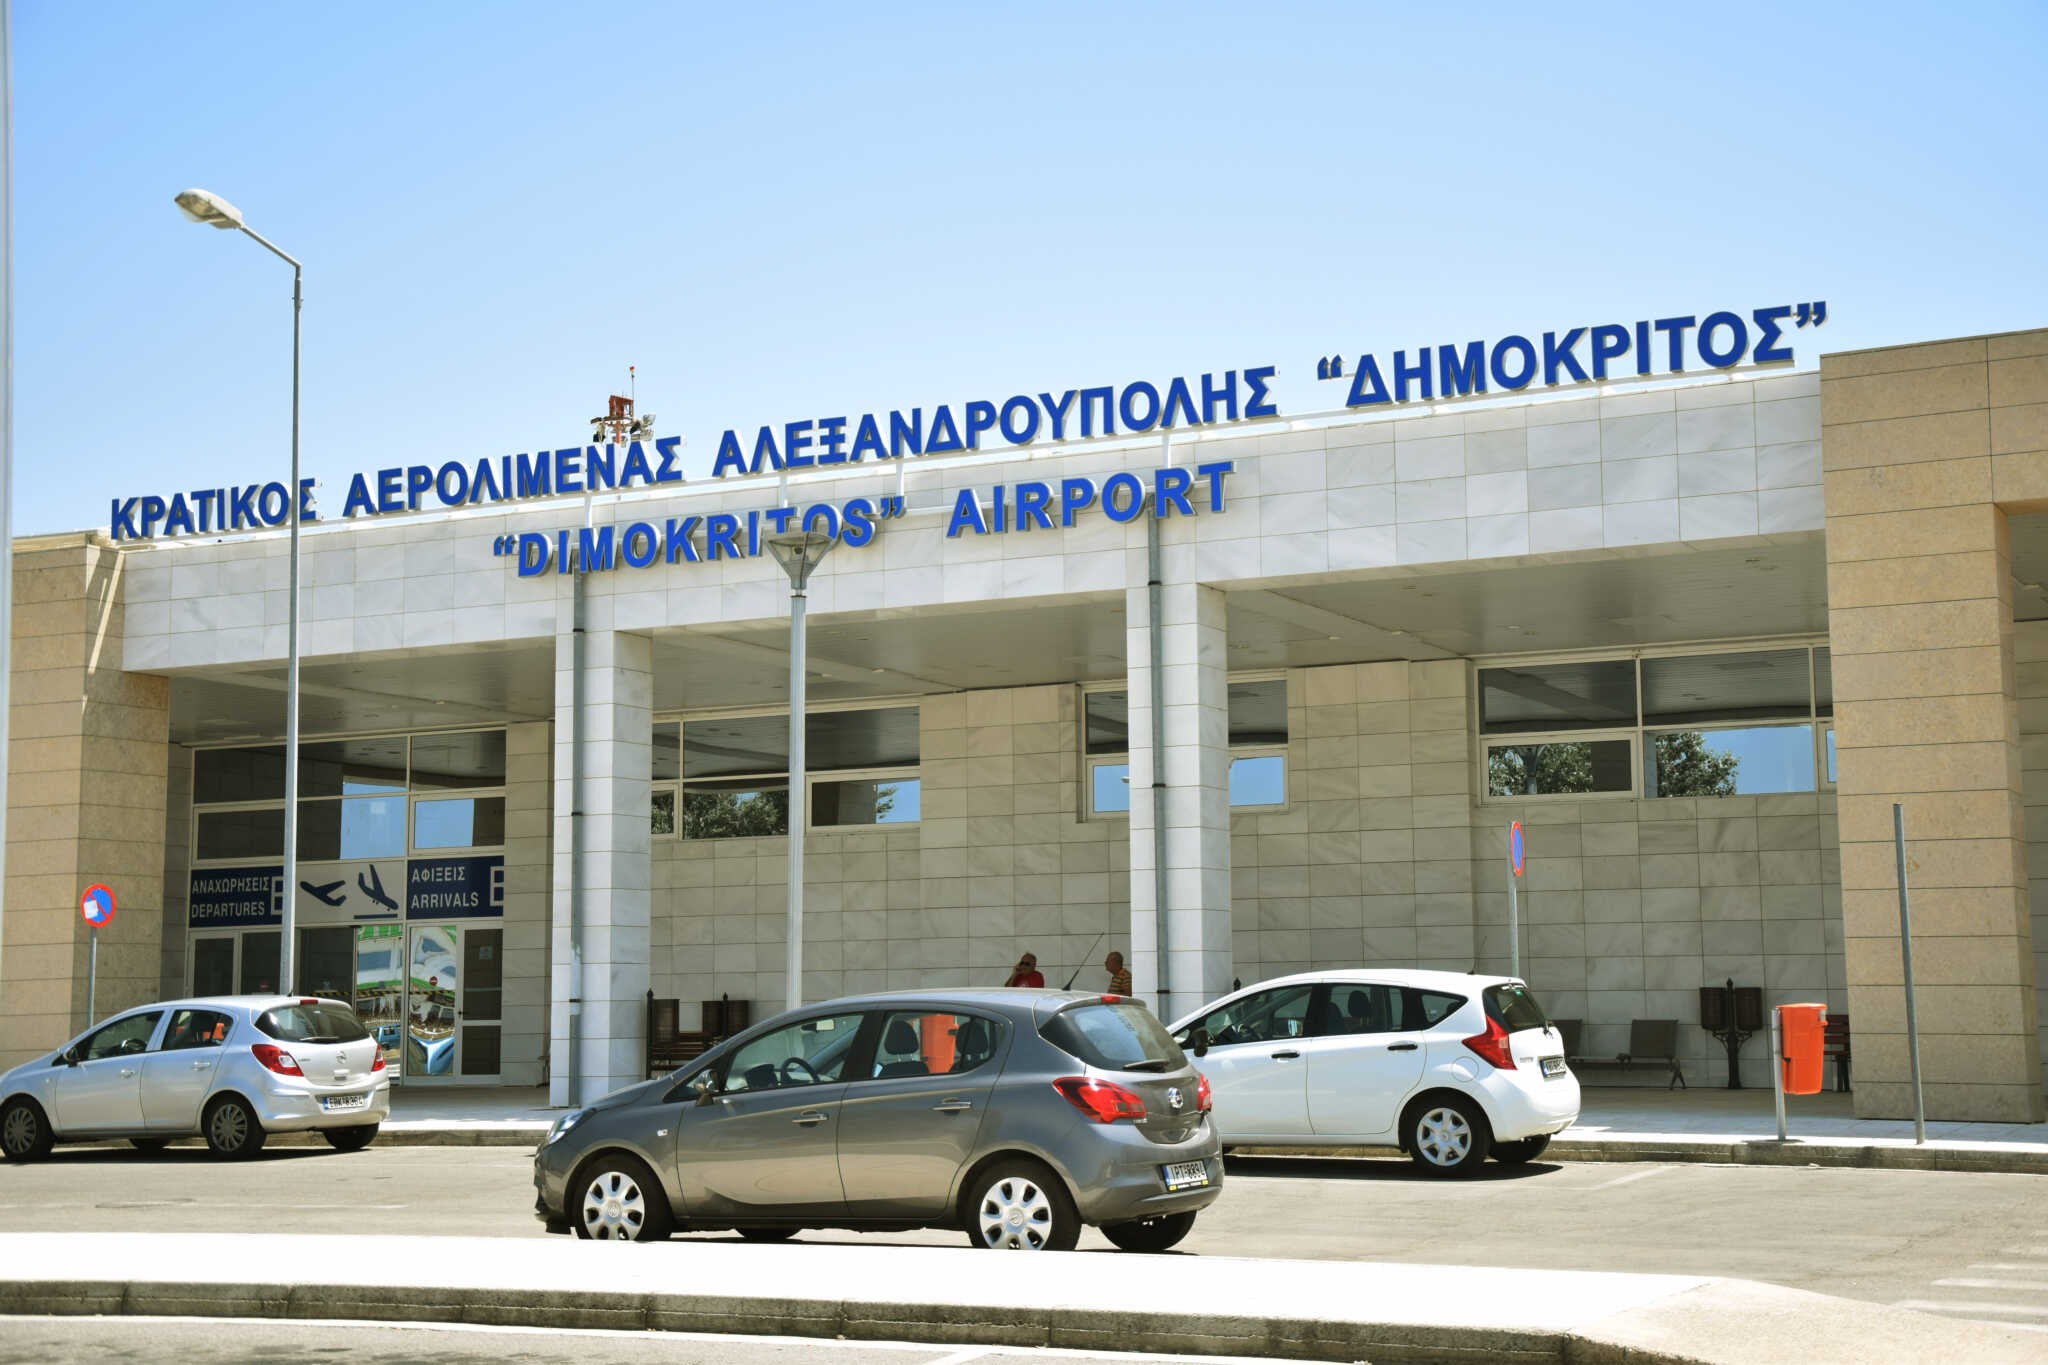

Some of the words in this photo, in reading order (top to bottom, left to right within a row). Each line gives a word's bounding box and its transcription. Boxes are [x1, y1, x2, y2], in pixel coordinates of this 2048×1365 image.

[111, 478, 317, 540] ΚΡΑΤΙΚΟΣ
[343, 435, 682, 517] ΑΕΡΟΛΙΜΕΝΑΣ
[712, 365, 1279, 476] ΑΛΕΞΑΝΔΡΟΥΠΟΛΗΣ
[1317, 301, 1828, 407] “ΔΗΜΟΚΡΙΤΟΣ”
[946, 461, 1235, 538] AIRPORT
[411, 866, 466, 883] ΑΦΙΞΕΙΣ
[191, 877, 270, 894] ΑΝΑΧΩΡΗΣΕΙΣ
[411, 892, 480, 909] ARRIVALS
[191, 901, 266, 919] DEPARTURES
